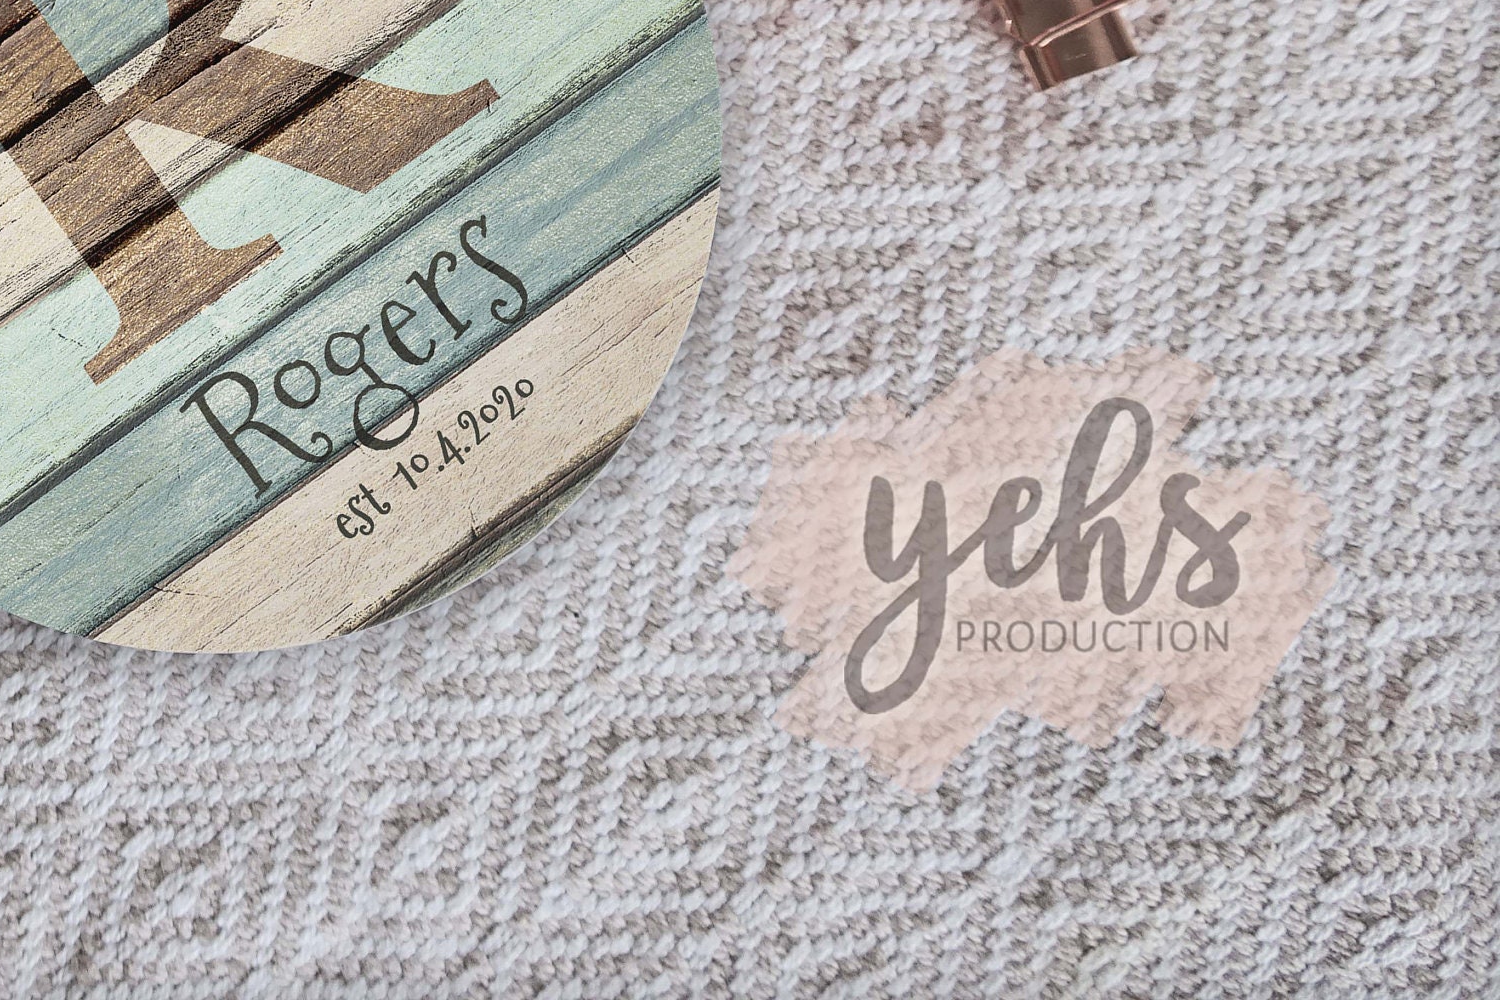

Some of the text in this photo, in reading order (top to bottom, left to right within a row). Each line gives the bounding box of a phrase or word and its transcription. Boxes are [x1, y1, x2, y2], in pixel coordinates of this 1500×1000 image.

[179, 215, 528, 499] Rogers
[336, 378, 534, 538] est 10.4.2020
